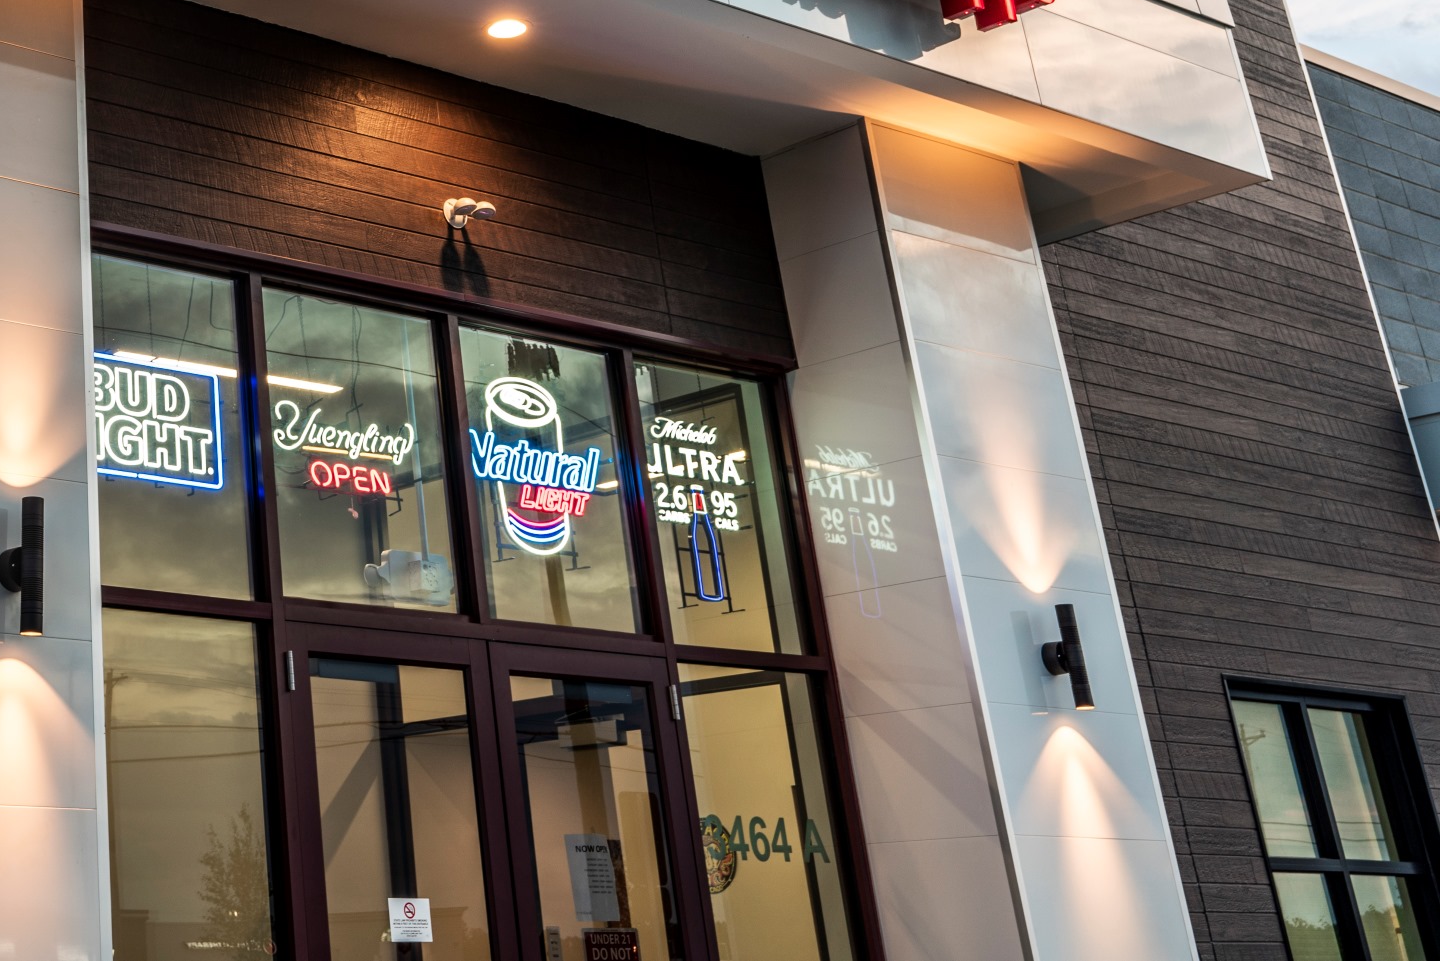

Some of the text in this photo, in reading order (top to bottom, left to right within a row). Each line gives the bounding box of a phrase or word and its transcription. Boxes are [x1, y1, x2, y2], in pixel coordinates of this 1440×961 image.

[93, 363, 190, 422] BUD
[94, 412, 214, 475] IGHT.
[274, 400, 415, 466] Yuengling
[650, 416, 717, 445] Michelob
[468, 428, 601, 492] Natural
[311, 461, 391, 495] OPEN
[520, 485, 591, 516] LIGHT
[655, 482, 687, 510] 2.6
[710, 490, 738, 517] 95
[714, 517, 739, 531] CALS
[575, 845, 595, 853] NOW
[704, 814, 792, 862] 3464
[805, 818, 831, 863] A
[590, 933, 632, 945] UNDER 21
[592, 947, 632, 961] DO NOT
